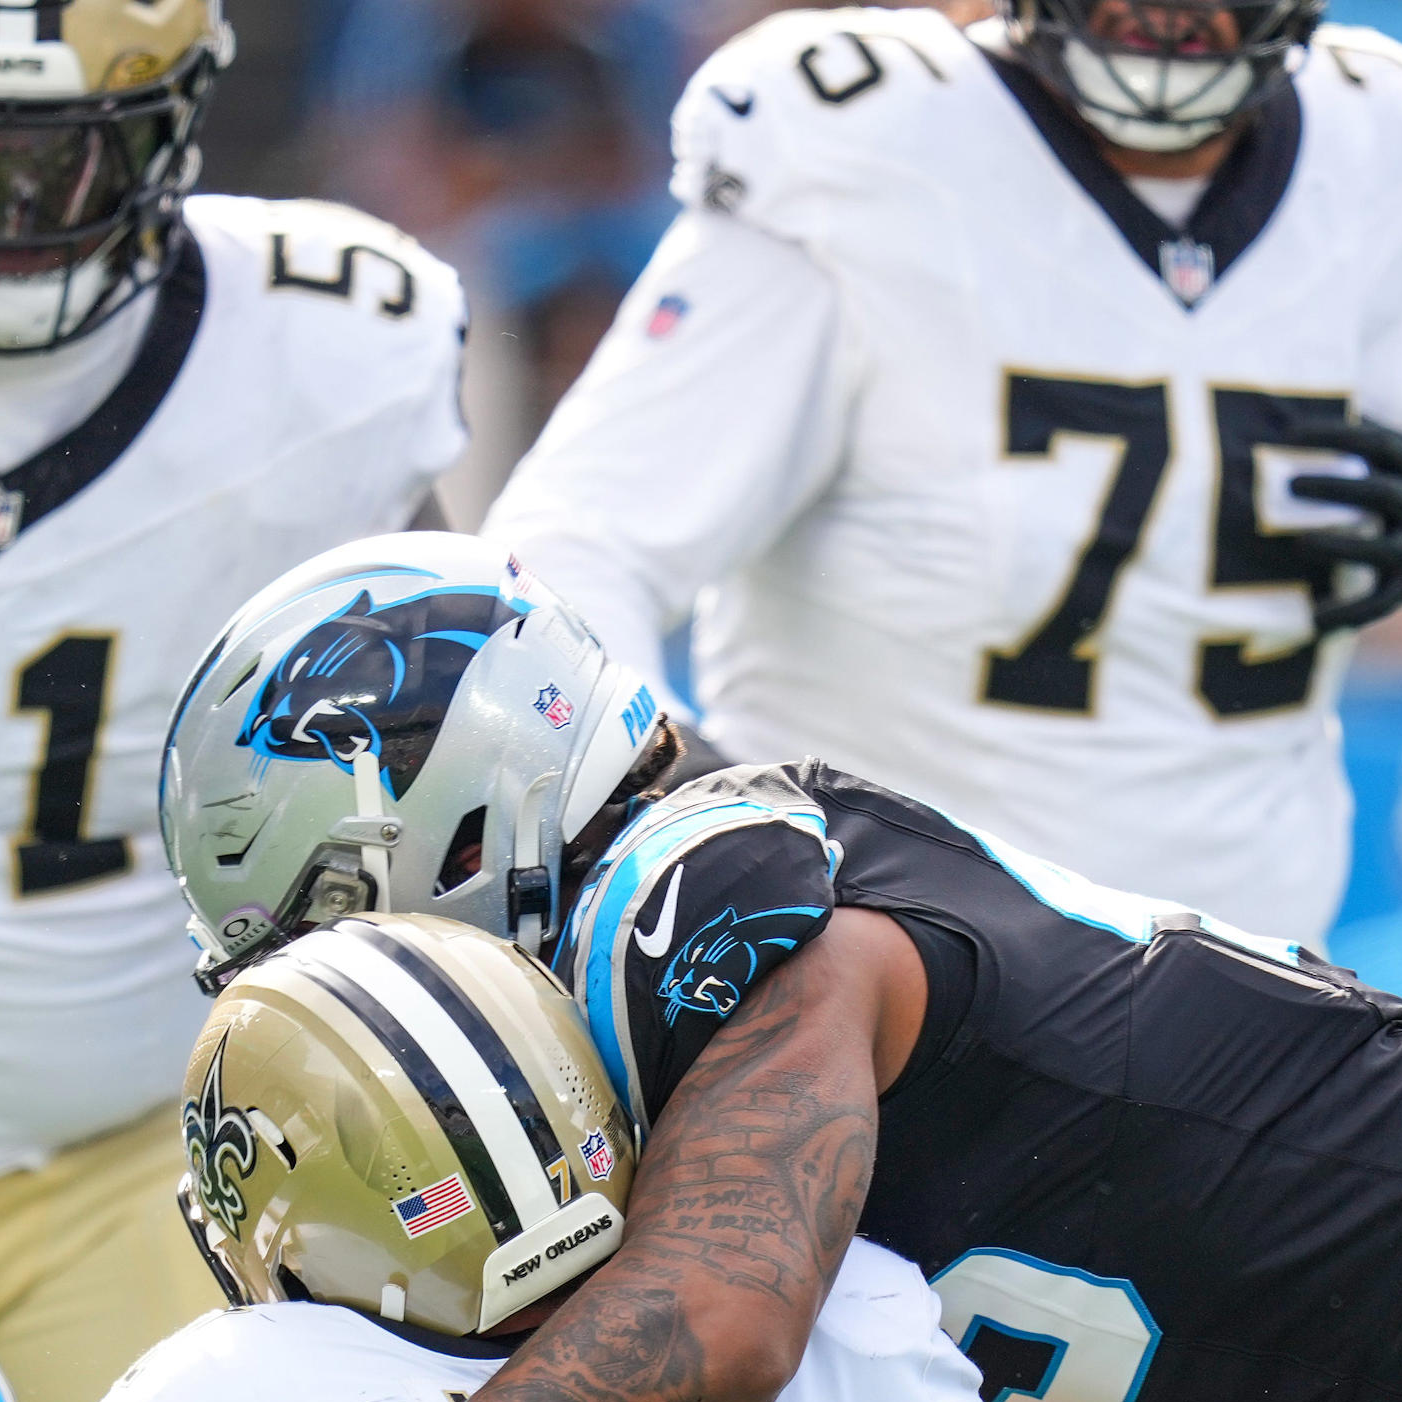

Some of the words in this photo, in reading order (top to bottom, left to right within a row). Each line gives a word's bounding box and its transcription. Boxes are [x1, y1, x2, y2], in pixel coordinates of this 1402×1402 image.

[978, 366, 1355, 722] 75
[227, 921, 269, 952] OAKLEY
[545, 1154, 572, 1206] 7
[589, 1147, 613, 1176] NFL
[501, 1253, 542, 1287] NEW
[545, 1213, 614, 1261] ORLEANS
